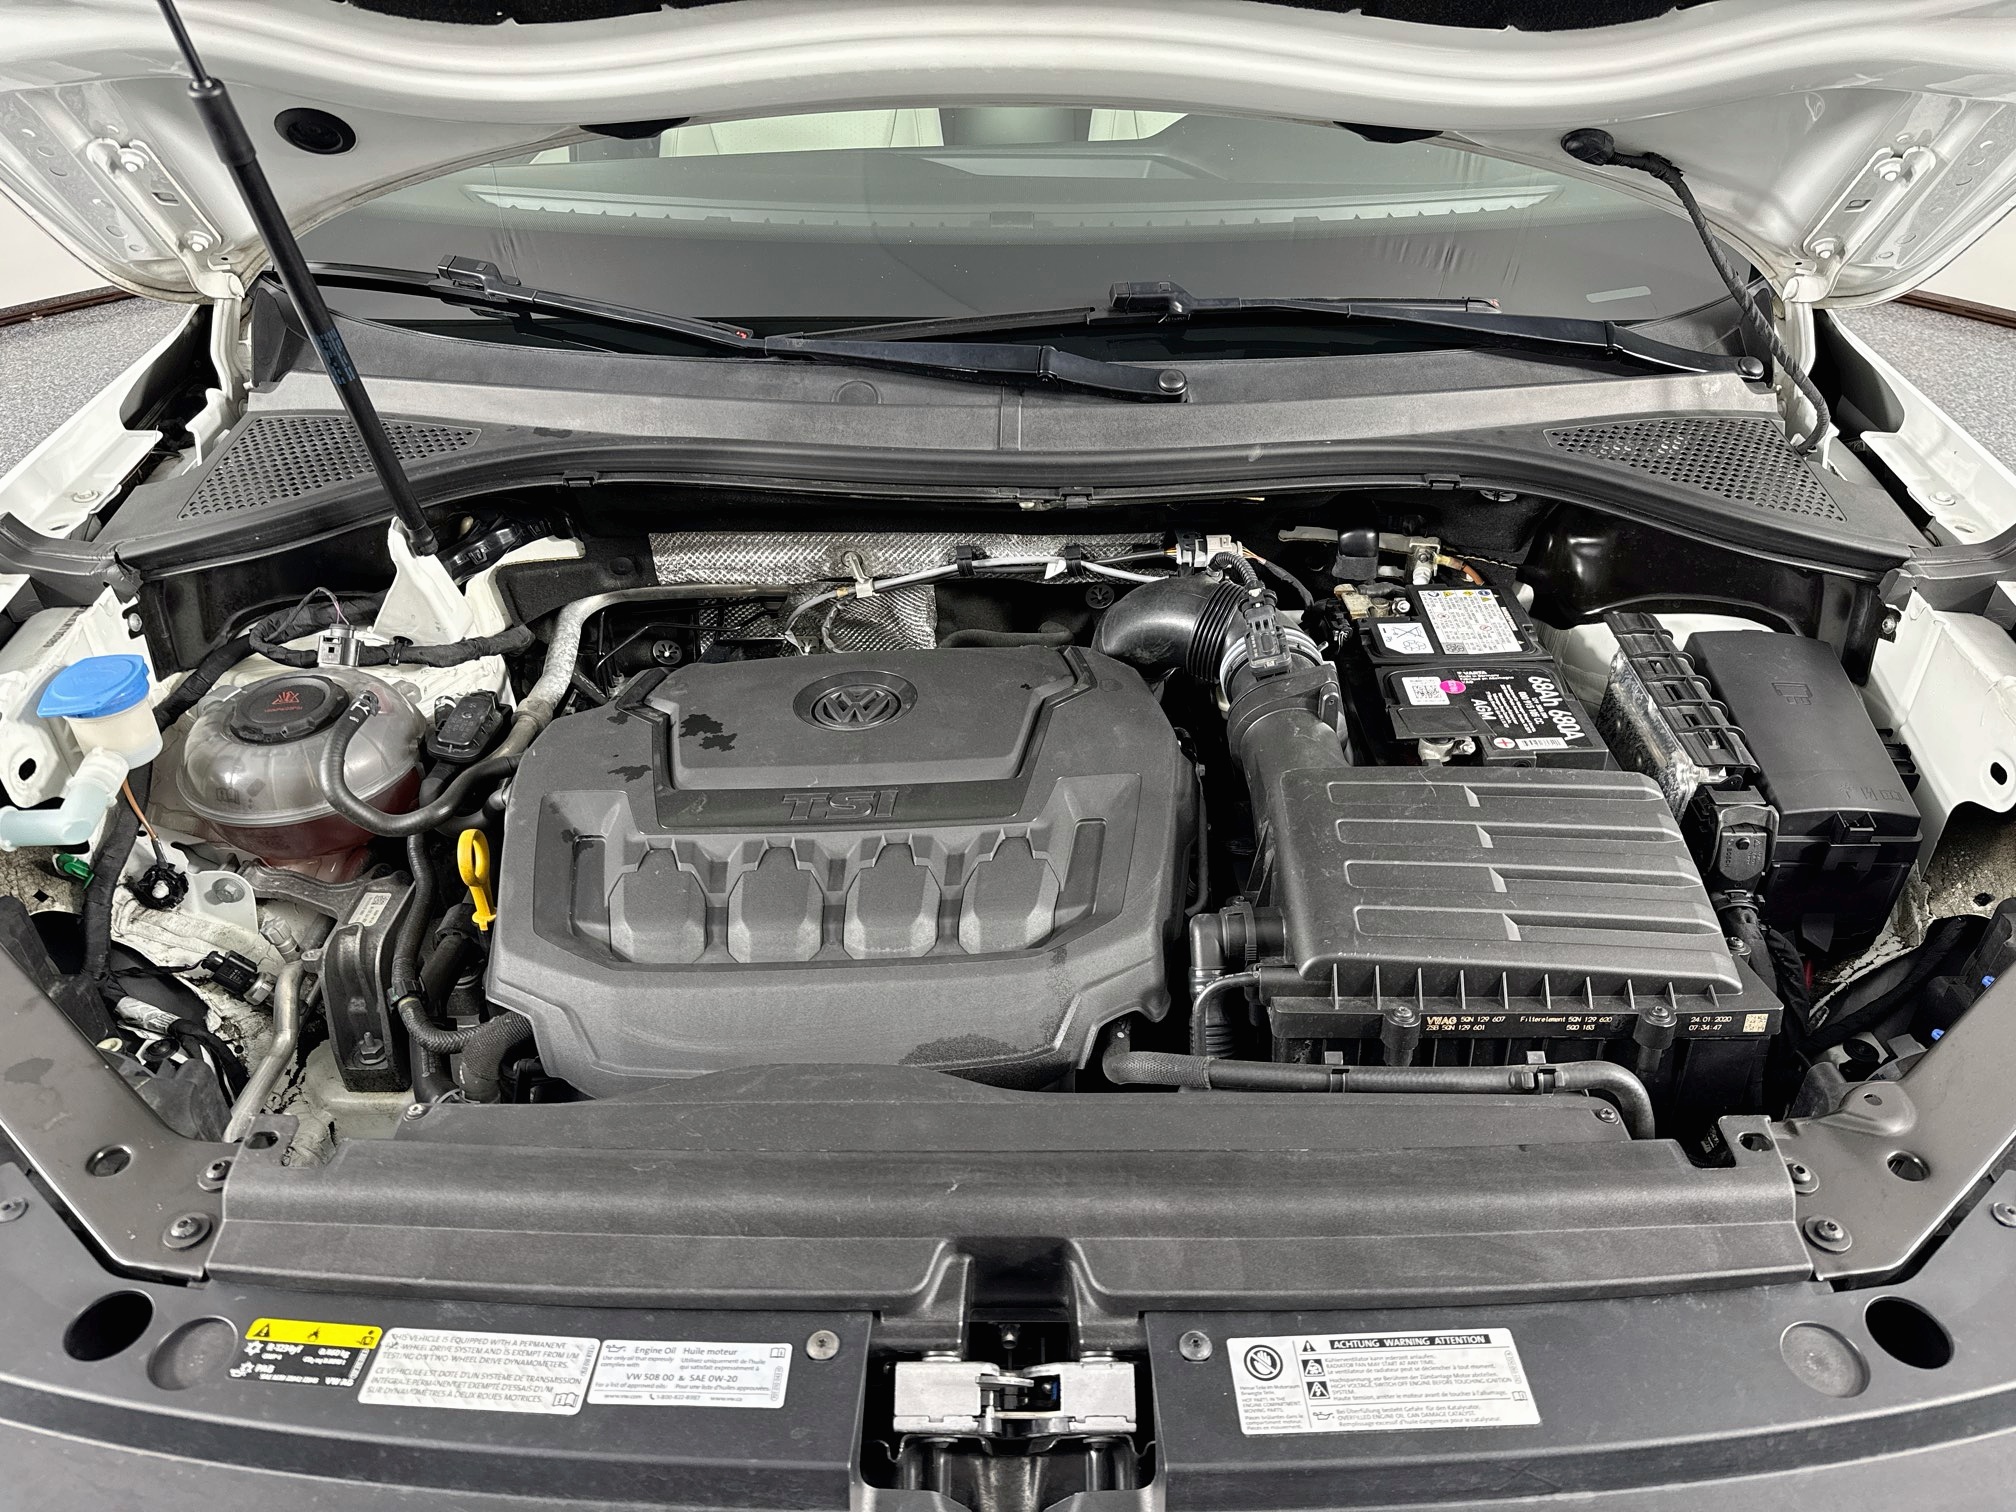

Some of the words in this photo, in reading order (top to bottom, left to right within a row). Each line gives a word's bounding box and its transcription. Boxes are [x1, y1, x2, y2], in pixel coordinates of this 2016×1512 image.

[1471, 698, 1497, 720] AGM
[1528, 676, 1563, 706] 68Ah
[1548, 709, 1585, 741] 680A
[782, 790, 899, 820] TSI
[410, 1334, 440, 1342] VEHICLE
[451, 1336, 488, 1345] EQUIPPED
[520, 1340, 567, 1349] PERMANENT
[1334, 1339, 1380, 1349] ACHTUNG
[1384, 1337, 1430, 1346] WARNING
[1434, 1335, 1486, 1345] ATTENTION
[383, 1351, 415, 1360] TESTING
[479, 1356, 503, 1365] DRIVE
[455, 1345, 483, 1354] SYSTEM
[484, 1347, 502, 1355] AND
[512, 1349, 541, 1357] EXEMPT
[543, 1350, 565, 1358] FROM
[635, 1347, 662, 1355] Engine
[526, 1375, 583, 1384] TRANSMISSION
[454, 1390, 475, 1398] DEUX
[477, 1392, 504, 1400] ROUES
